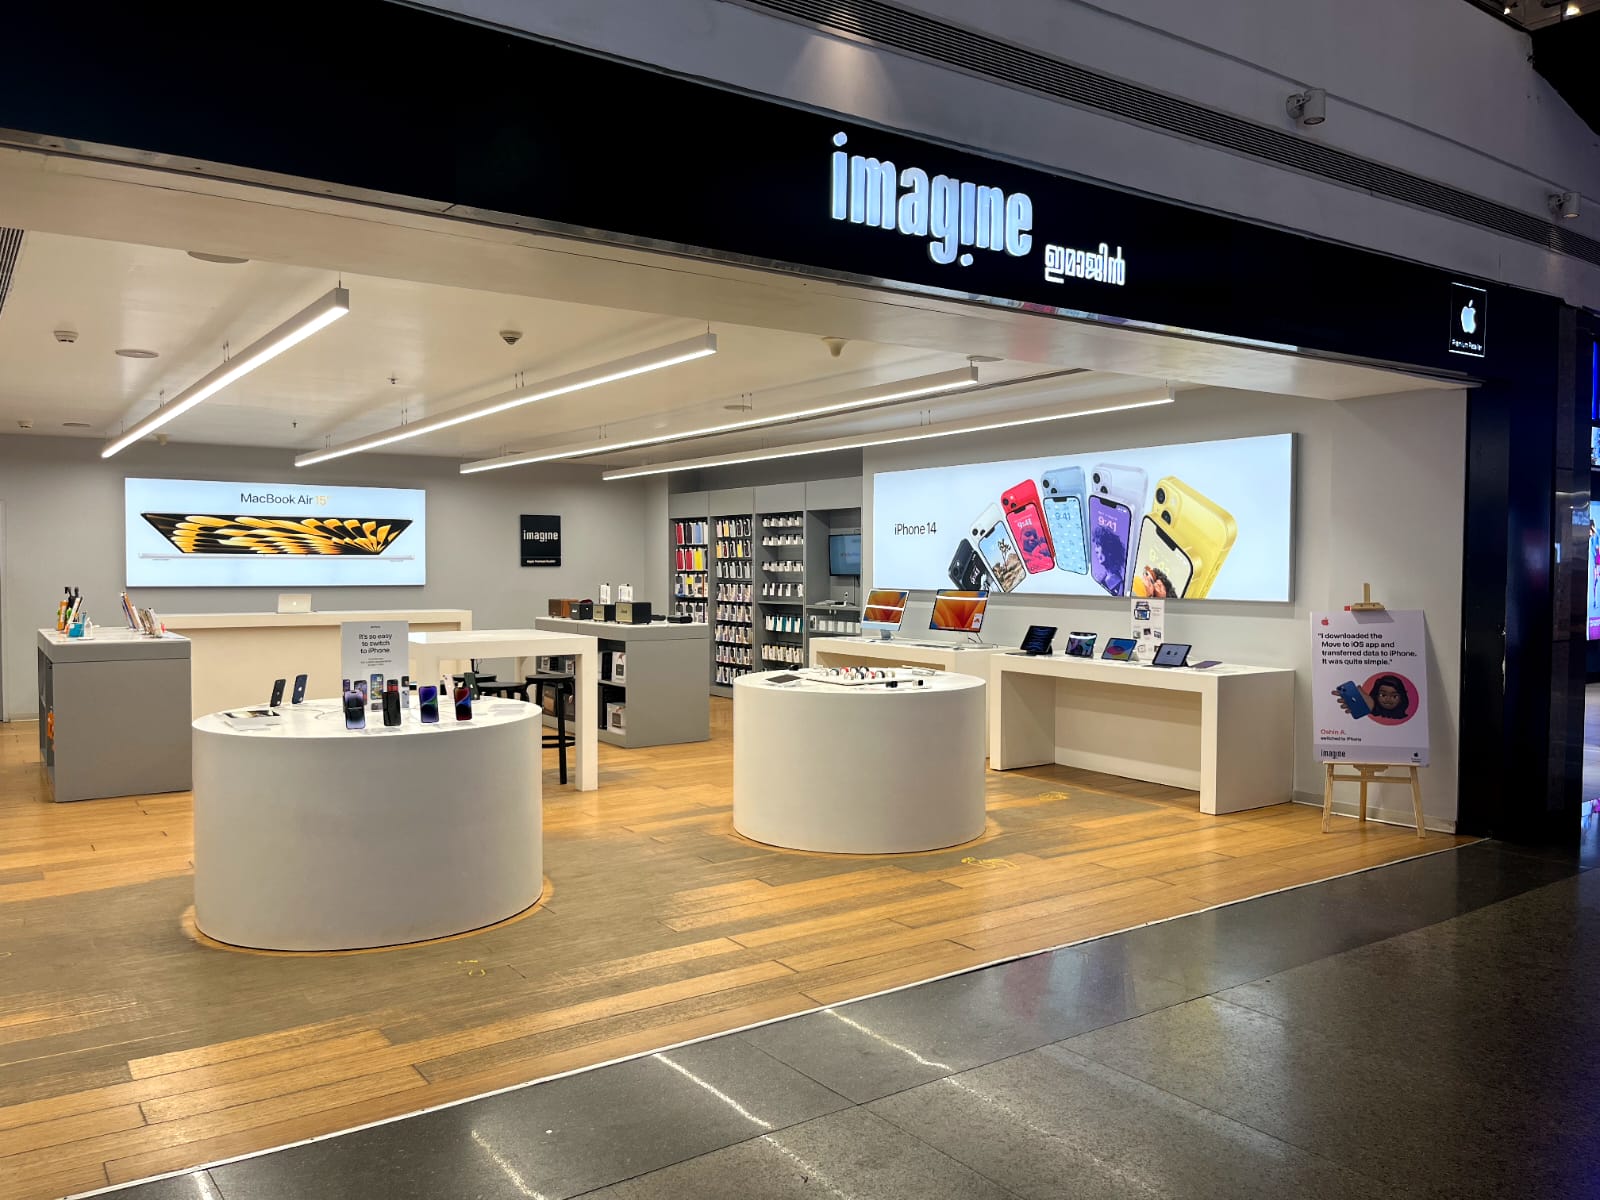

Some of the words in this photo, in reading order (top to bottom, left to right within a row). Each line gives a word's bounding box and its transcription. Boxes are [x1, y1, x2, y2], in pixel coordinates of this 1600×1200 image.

[832, 132, 1033, 267] imagine
[240, 492, 296, 504] MacBook
[297, 494, 313, 505] Air
[894, 523, 926, 535] iPhone
[926, 521, 937, 535] 14
[523, 529, 559, 543] imagine
[1365, 641, 1380, 649] app
[1344, 658, 1363, 666] quite
